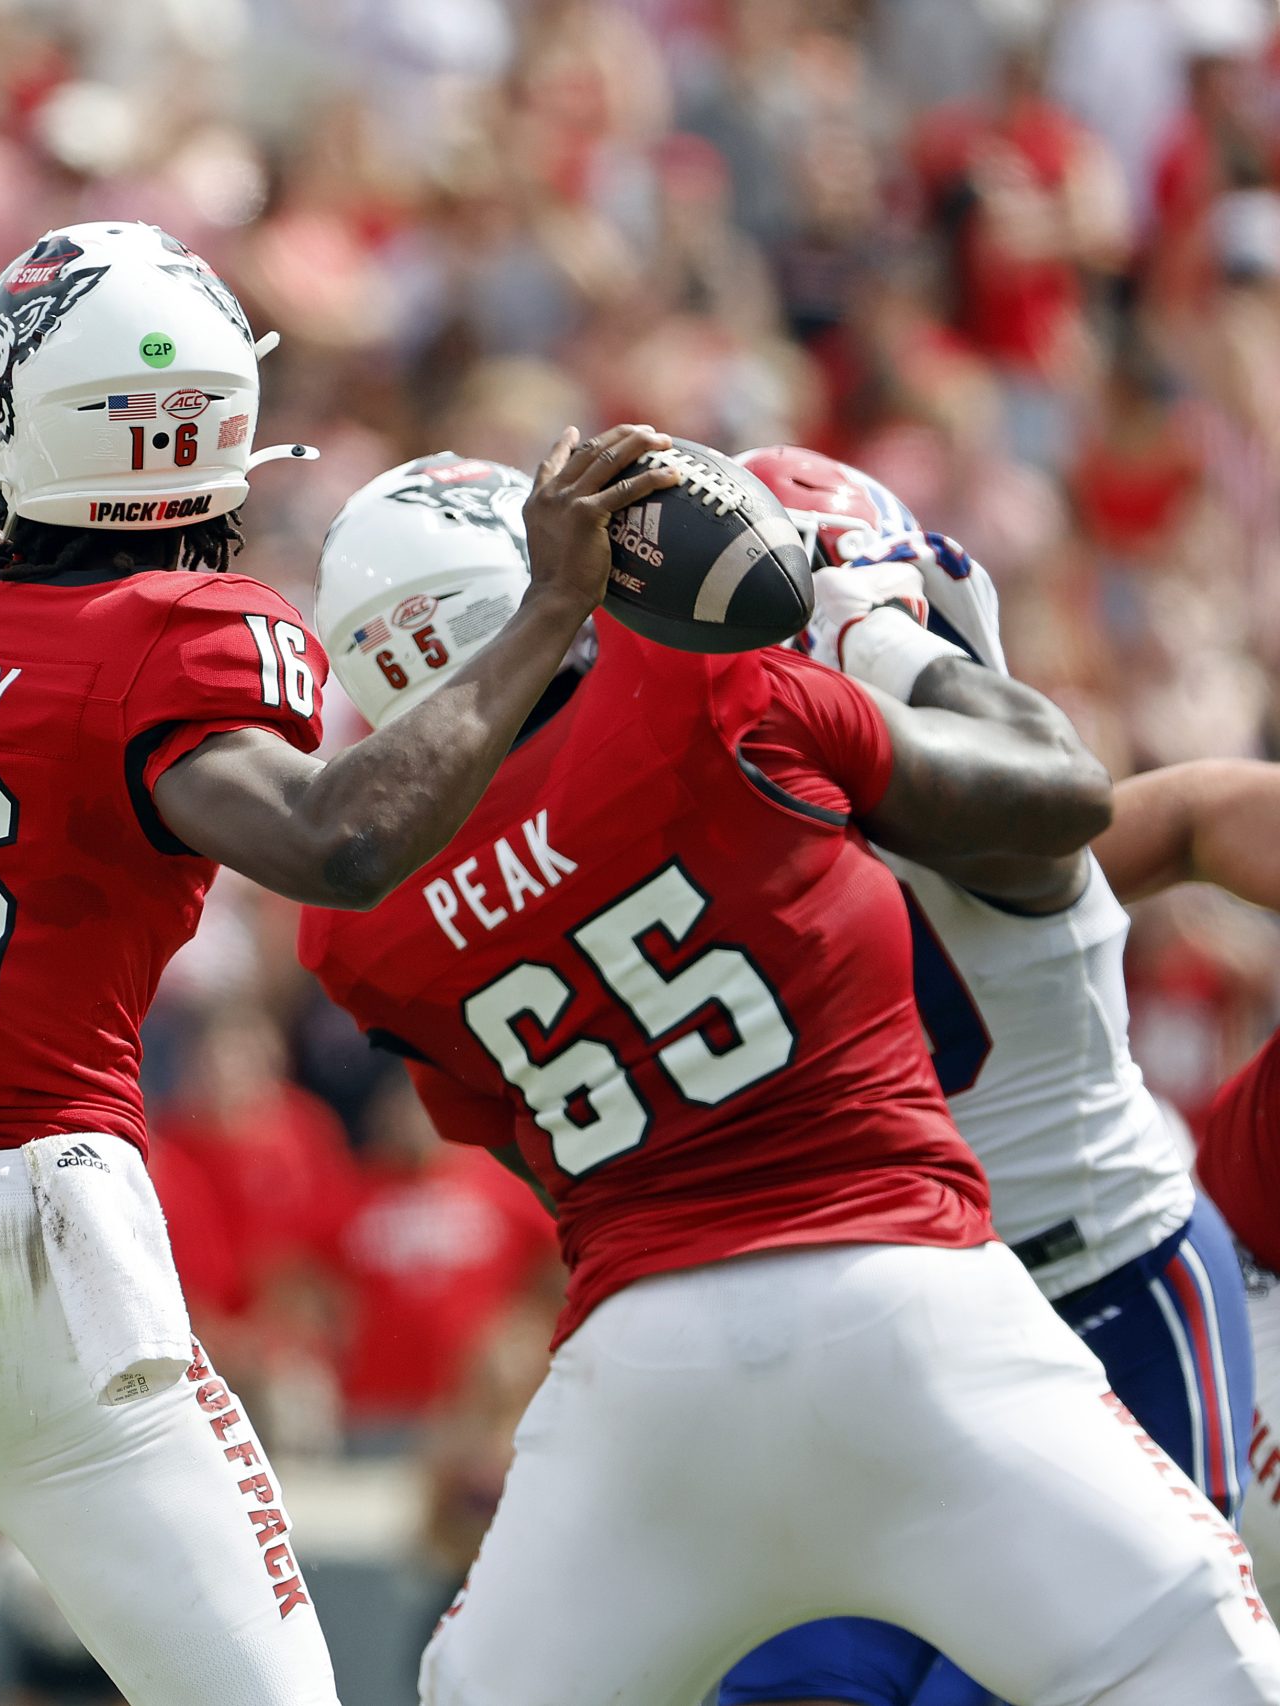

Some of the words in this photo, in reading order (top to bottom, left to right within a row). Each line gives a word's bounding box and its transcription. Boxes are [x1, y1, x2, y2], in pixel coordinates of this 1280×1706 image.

[18, 264, 53, 284] STATE
[142, 342, 172, 357] C2P
[170, 394, 204, 409] ACC
[608, 522, 664, 568] didas
[243, 613, 316, 720] 16
[422, 808, 579, 951] PEAK
[460, 853, 800, 1182] 65
[57, 1156, 111, 1174] adidas
